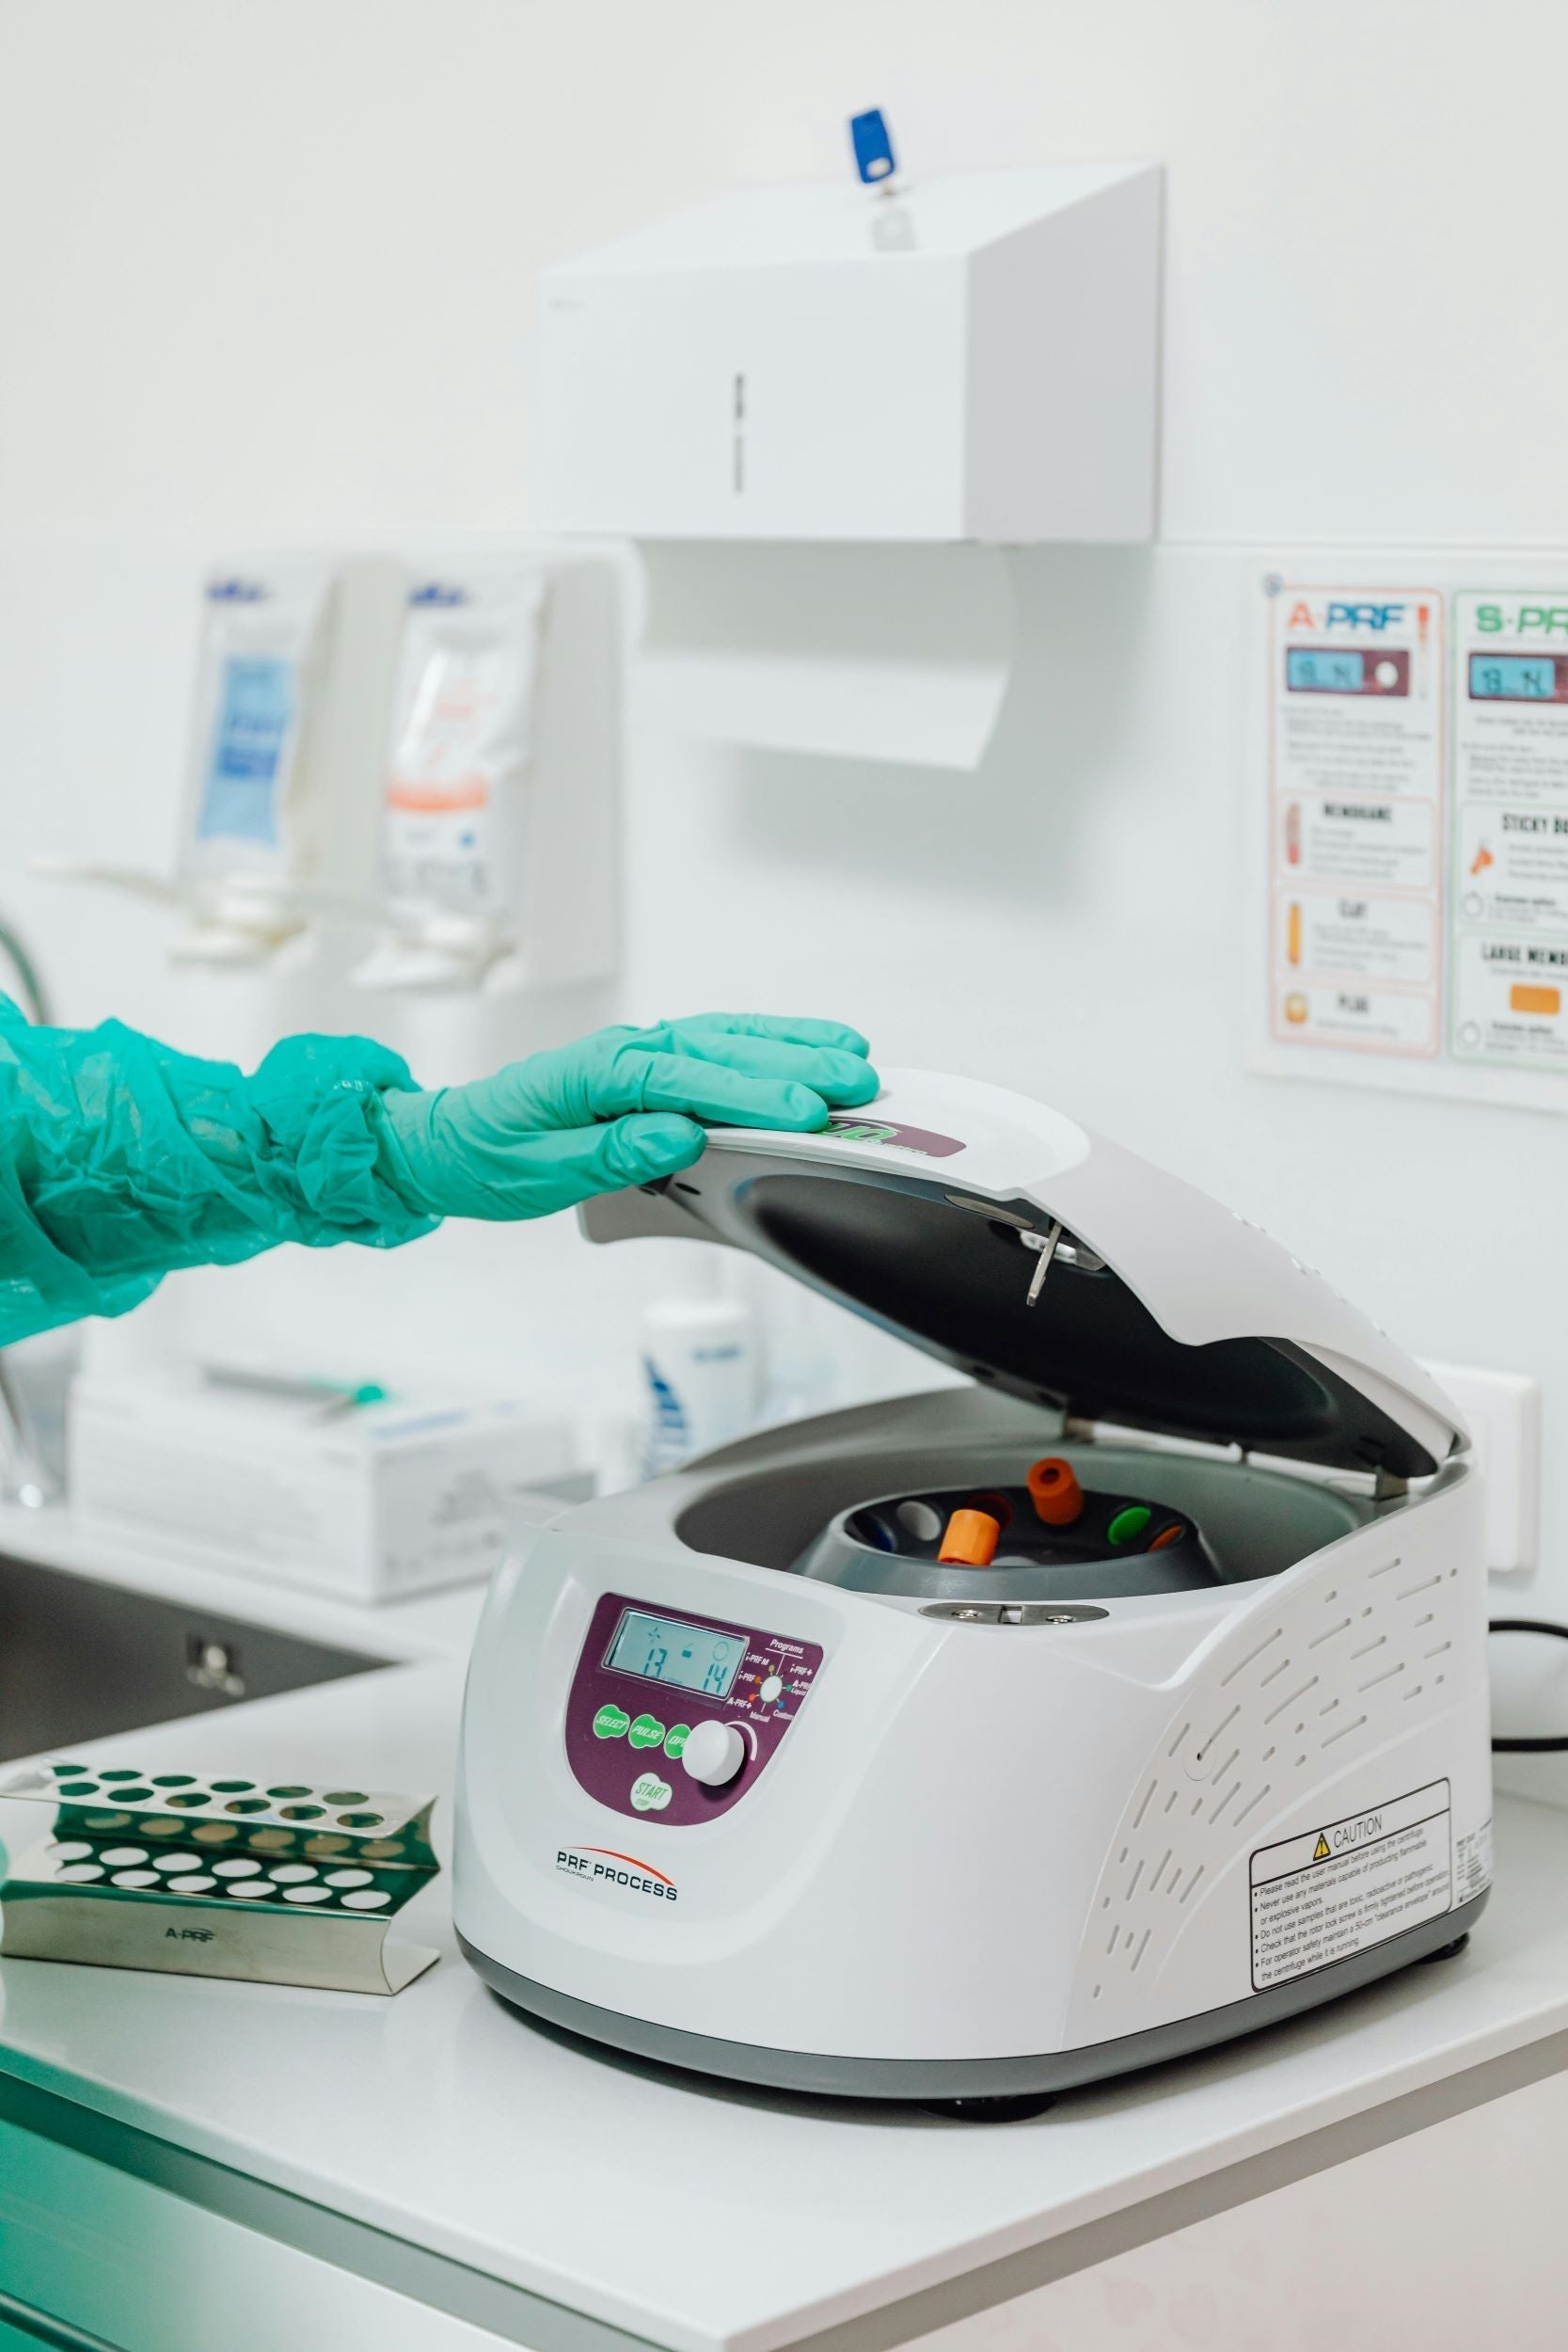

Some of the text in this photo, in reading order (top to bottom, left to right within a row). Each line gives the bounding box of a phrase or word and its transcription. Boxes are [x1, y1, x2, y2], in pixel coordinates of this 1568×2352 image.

[1503, 813, 1546, 833] STICKY
[769, 1639, 804, 1654] Programs
[703, 1663, 728, 1692] 14
[738, 1671, 756, 1682] i-PRF
[726, 1697, 752, 1708] A-PRF+
[595, 1715, 628, 1730] SELECT
[632, 1725, 662, 1740] PULSE
[635, 1783, 669, 1800] START
[1334, 1814, 1382, 1848] CAUTION
[1260, 1883, 1282, 1895] Please
[1284, 1877, 1298, 1887] read
[1300, 1873, 1309, 1883] the
[1312, 1867, 1325, 1878] user
[1327, 1859, 1349, 1871] manual
[1351, 1851, 1369, 1863] before
[1370, 1844, 1385, 1855] using
[1397, 1828, 1422, 1844] centrifuge
[555, 1865, 594, 1882] CHOUKROUN
[557, 1851, 677, 1901] PRF PROCESS
[1260, 1899, 1279, 1910] Never
[1282, 1894, 1293, 1903] use
[1295, 1890, 1306, 1899] any
[1309, 1878, 1336, 1891] materials
[1338, 1868, 1360, 1883] capable
[1362, 1864, 1368, 1872] of
[1370, 1852, 1398, 1870] producing
[1260, 1930, 1270, 1939] Do
[1272, 1925, 1282, 1933] not
[1285, 1921, 1295, 1931] use
[1297, 1910, 1323, 1926] samples
[1325, 1905, 1337, 1915] that
[1338, 1900, 1347, 1910] are
[1366, 1881, 1395, 1898] radioactive
[1260, 1940, 1280, 1952] Check
[1284, 1933, 1295, 1944] that
[1297, 1931, 1307, 1939] the
[1309, 1924, 1323, 1934] rotor
[1325, 1919, 1337, 1928] lock
[1338, 1913, 1355, 1923] screw
[1364, 1902, 1378, 1912] firmly
[1407, 1882, 1423, 1894] before
[1269, 1906, 1299, 1922] explosive
[165, 1928, 214, 1943] A-PRF
[1261, 1957, 1272, 1966] For
[1274, 1947, 1300, 1962] operator
[1303, 1939, 1321, 1951] safety
[1323, 1928, 1348, 1942] maintain
[1261, 1972, 1272, 1980] the
[1274, 1959, 1305, 1976] centrifuge
[1307, 1952, 1323, 1963] while
